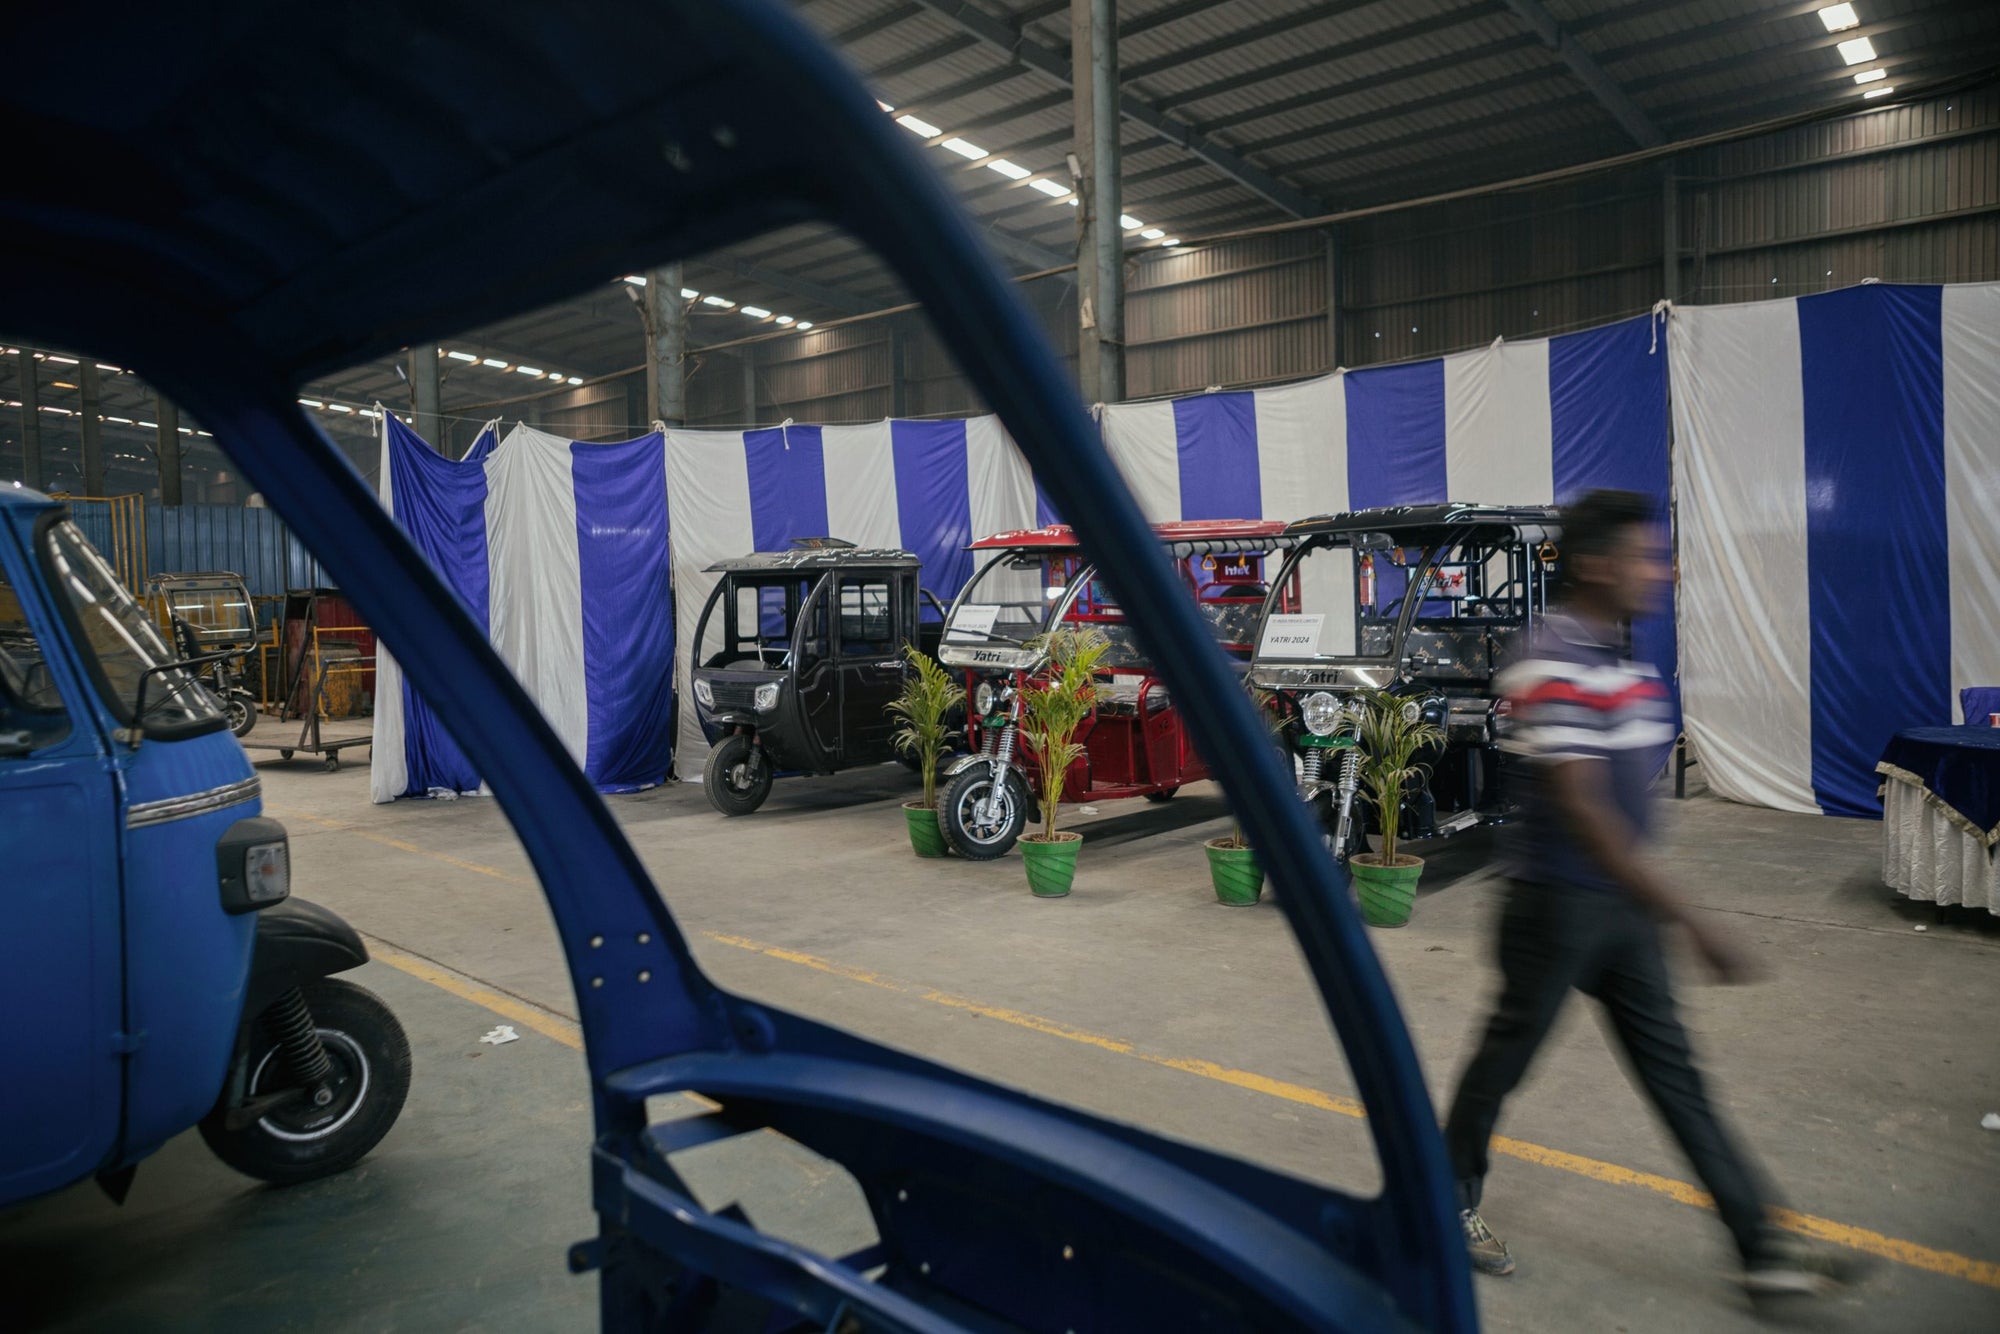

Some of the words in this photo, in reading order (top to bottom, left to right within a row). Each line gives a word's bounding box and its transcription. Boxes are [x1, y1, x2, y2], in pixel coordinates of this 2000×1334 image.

[1270, 636, 1291, 644] YATRI
[1291, 636, 1310, 644] 2024
[973, 650, 1002, 661] Yatri
[1301, 670, 1339, 683] Yatri
